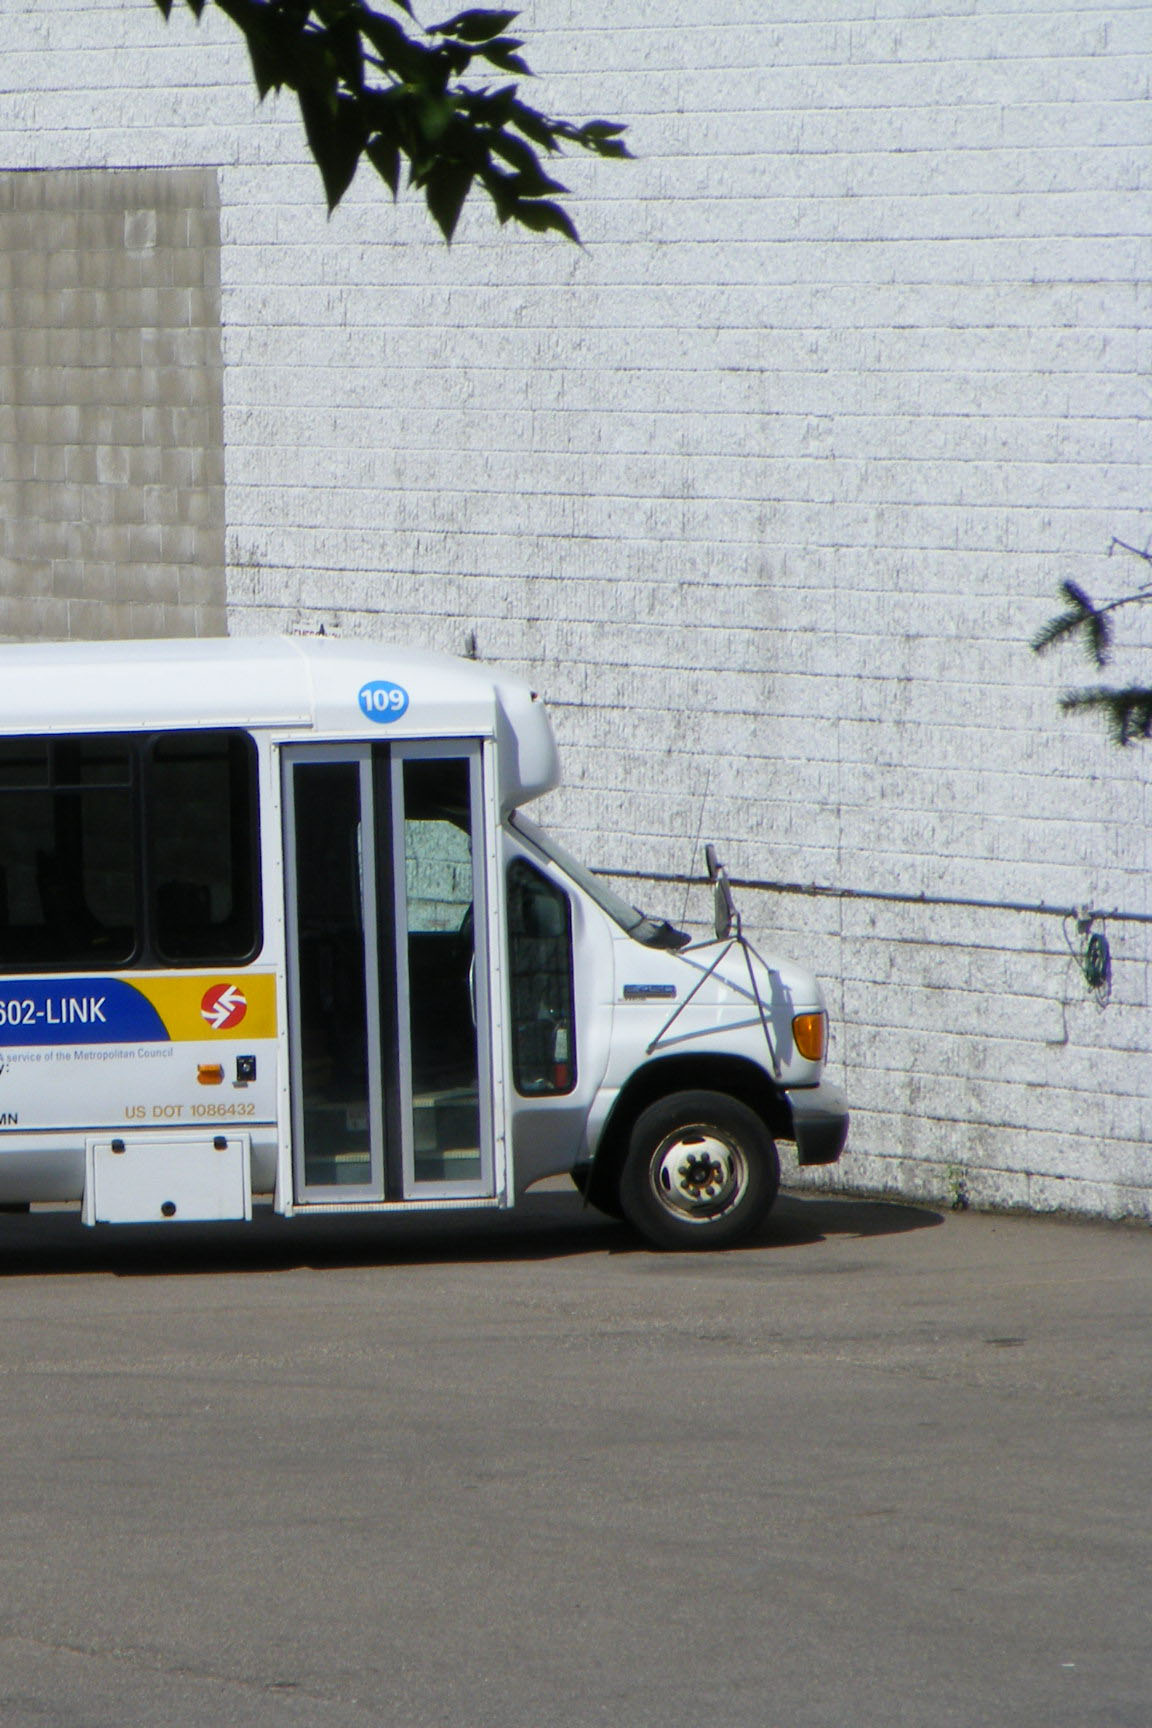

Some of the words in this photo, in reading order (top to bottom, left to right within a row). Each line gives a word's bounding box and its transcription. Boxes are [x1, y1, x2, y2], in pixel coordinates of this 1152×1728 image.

[360, 689, 404, 711] 109
[7, 1052, 41, 1062] service
[44, 1051, 55, 1061] of
[56, 1051, 71, 1061] the
[74, 1049, 135, 1061] Metropolitan
[138, 1047, 174, 1058] Council
[124, 1105, 146, 1119] US
[152, 1104, 184, 1118] DOT
[191, 1103, 256, 1117] 1086432
